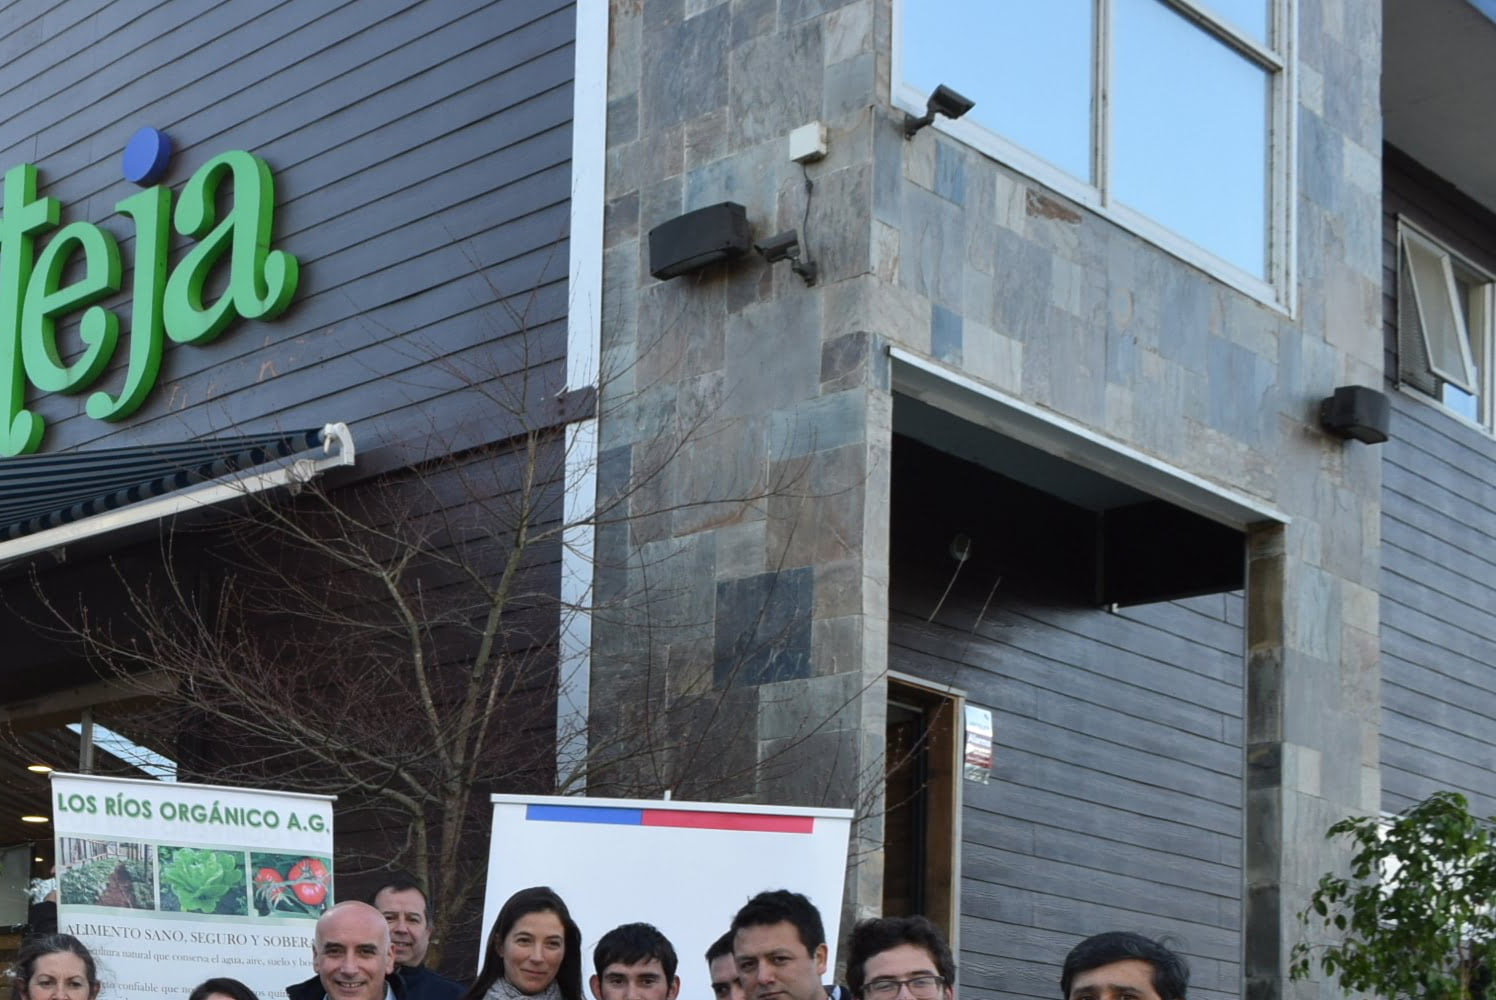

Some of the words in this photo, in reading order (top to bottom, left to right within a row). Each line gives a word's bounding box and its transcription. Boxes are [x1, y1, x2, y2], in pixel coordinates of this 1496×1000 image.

[57, 792, 97, 814] LOS
[105, 792, 153, 820] RÍOS
[159, 800, 280, 829] ORGÁNICO
[287, 812, 331, 834] A.G.
[66, 923, 141, 939] ALIMENTO
[144, 929, 188, 943] SANO,
[190, 931, 247, 946] SEGURO
[250, 935, 259, 946] Y
[122, 949, 152, 960] natural
[154, 953, 169, 963] que
[118, 981, 159, 993] confiable
[161, 985, 180, 995] que
